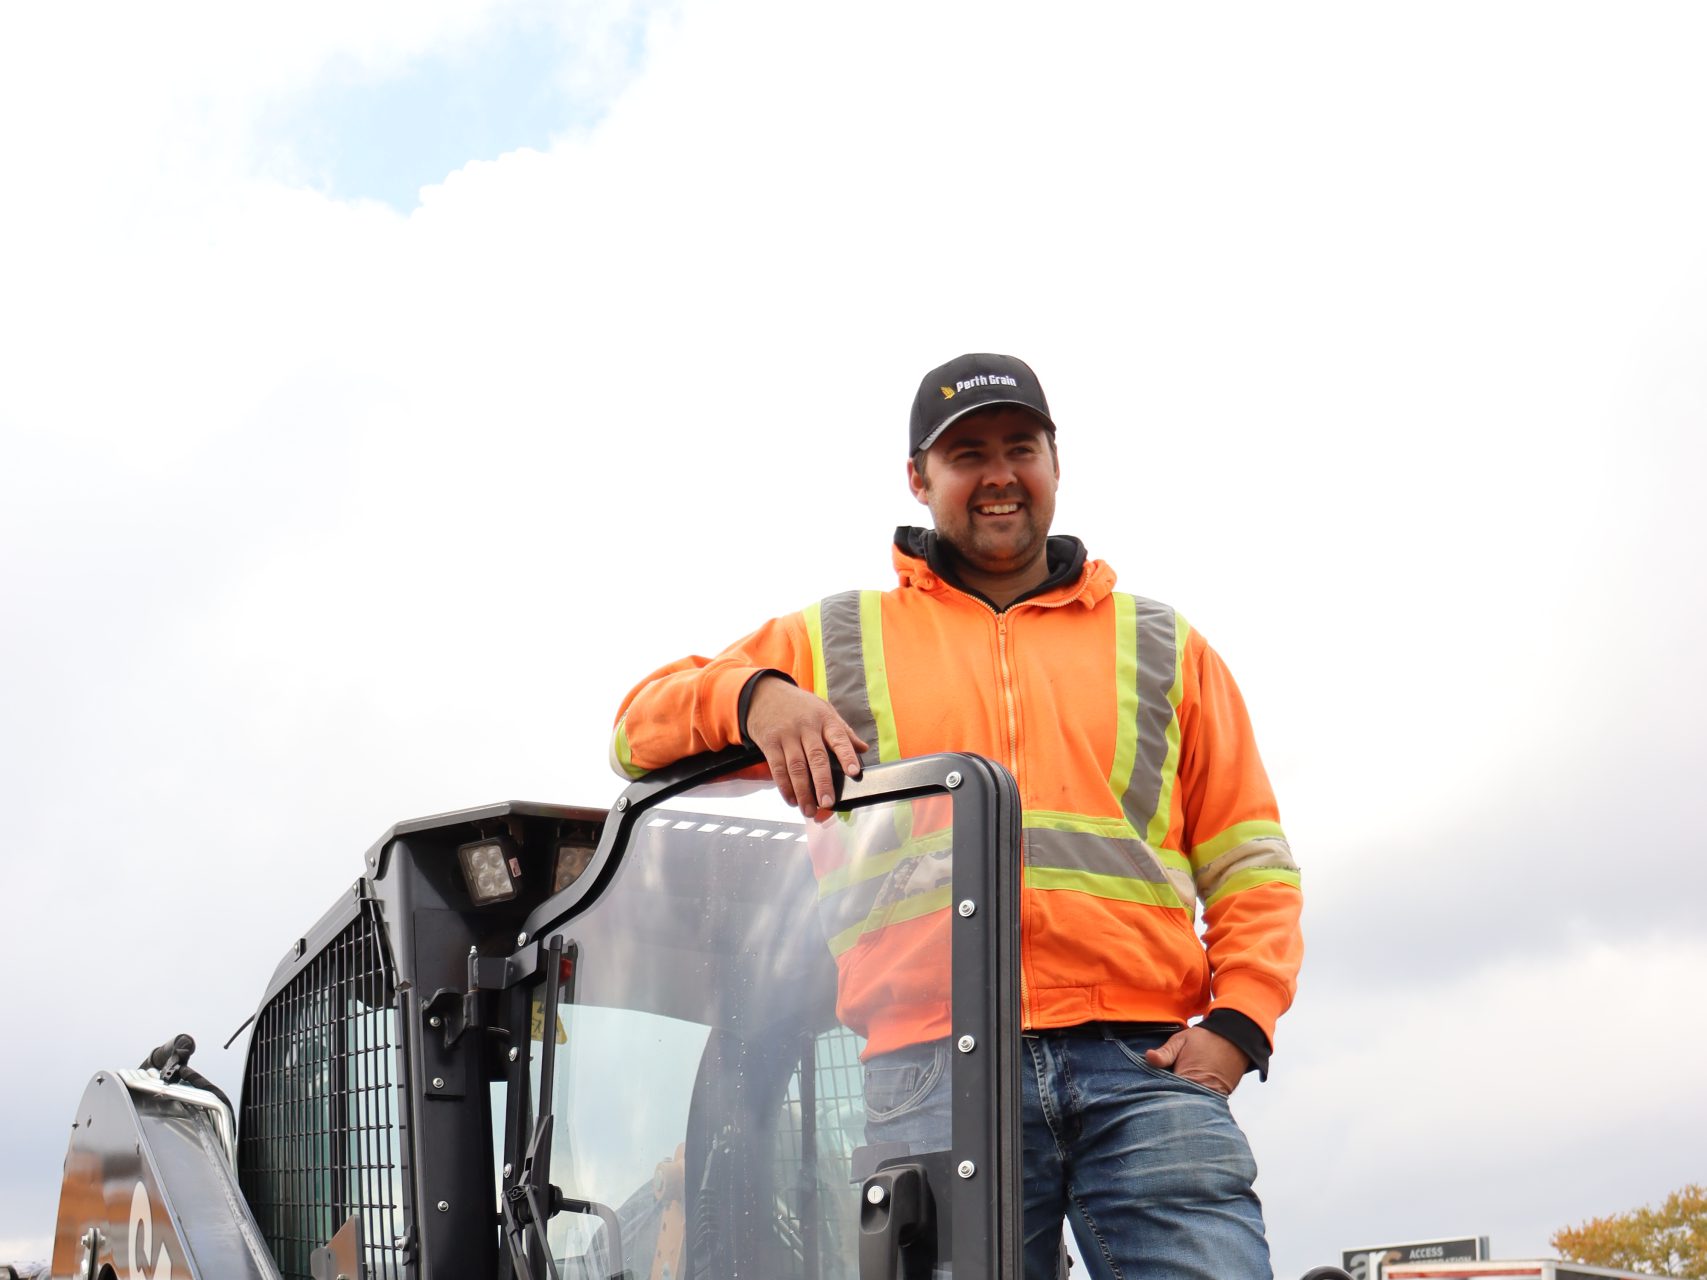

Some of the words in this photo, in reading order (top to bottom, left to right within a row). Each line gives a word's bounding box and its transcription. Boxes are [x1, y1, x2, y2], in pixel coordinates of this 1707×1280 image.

[956, 375, 988, 392] Perth
[989, 375, 1017, 387] Grain
[1409, 1246, 1444, 1259] ACCESS
